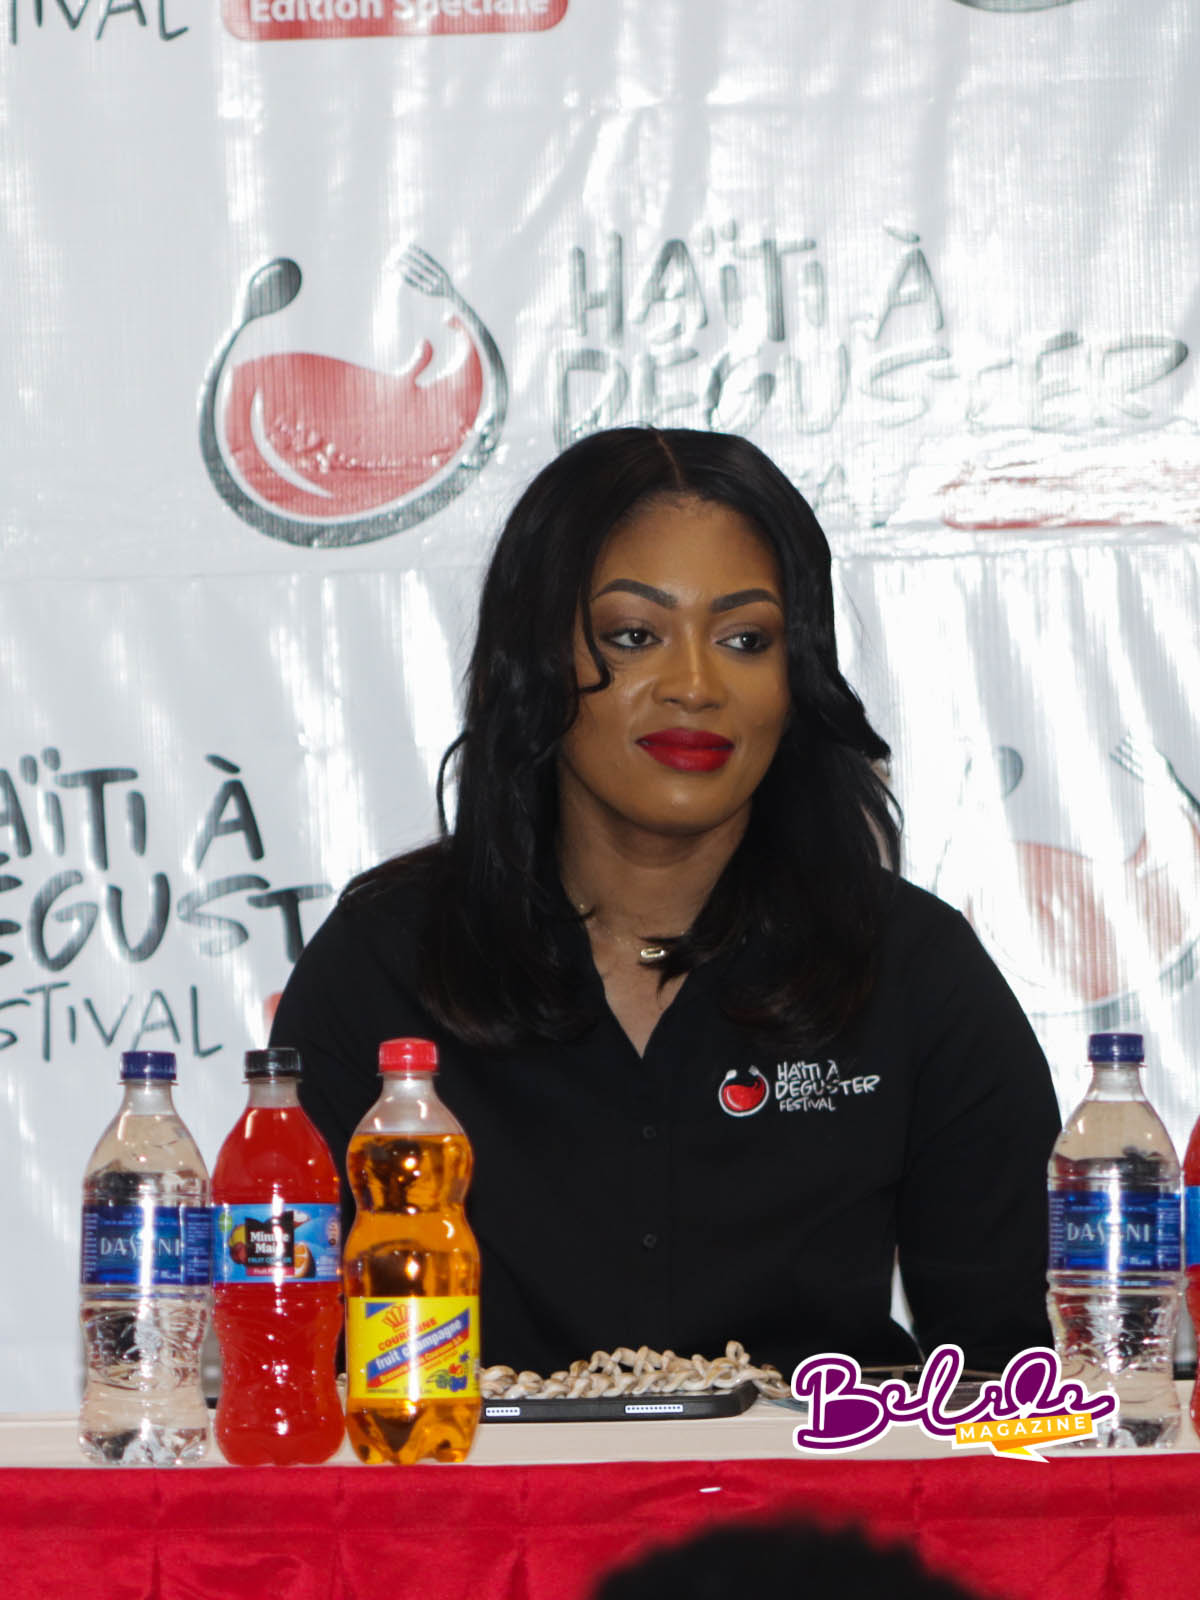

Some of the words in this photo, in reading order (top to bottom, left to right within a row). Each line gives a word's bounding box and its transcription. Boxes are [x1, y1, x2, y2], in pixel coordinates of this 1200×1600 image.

[197, 754, 264, 869] À
[779, 1097, 837, 1113] FESTIVAL
[250, 1231, 290, 1242] Minue
